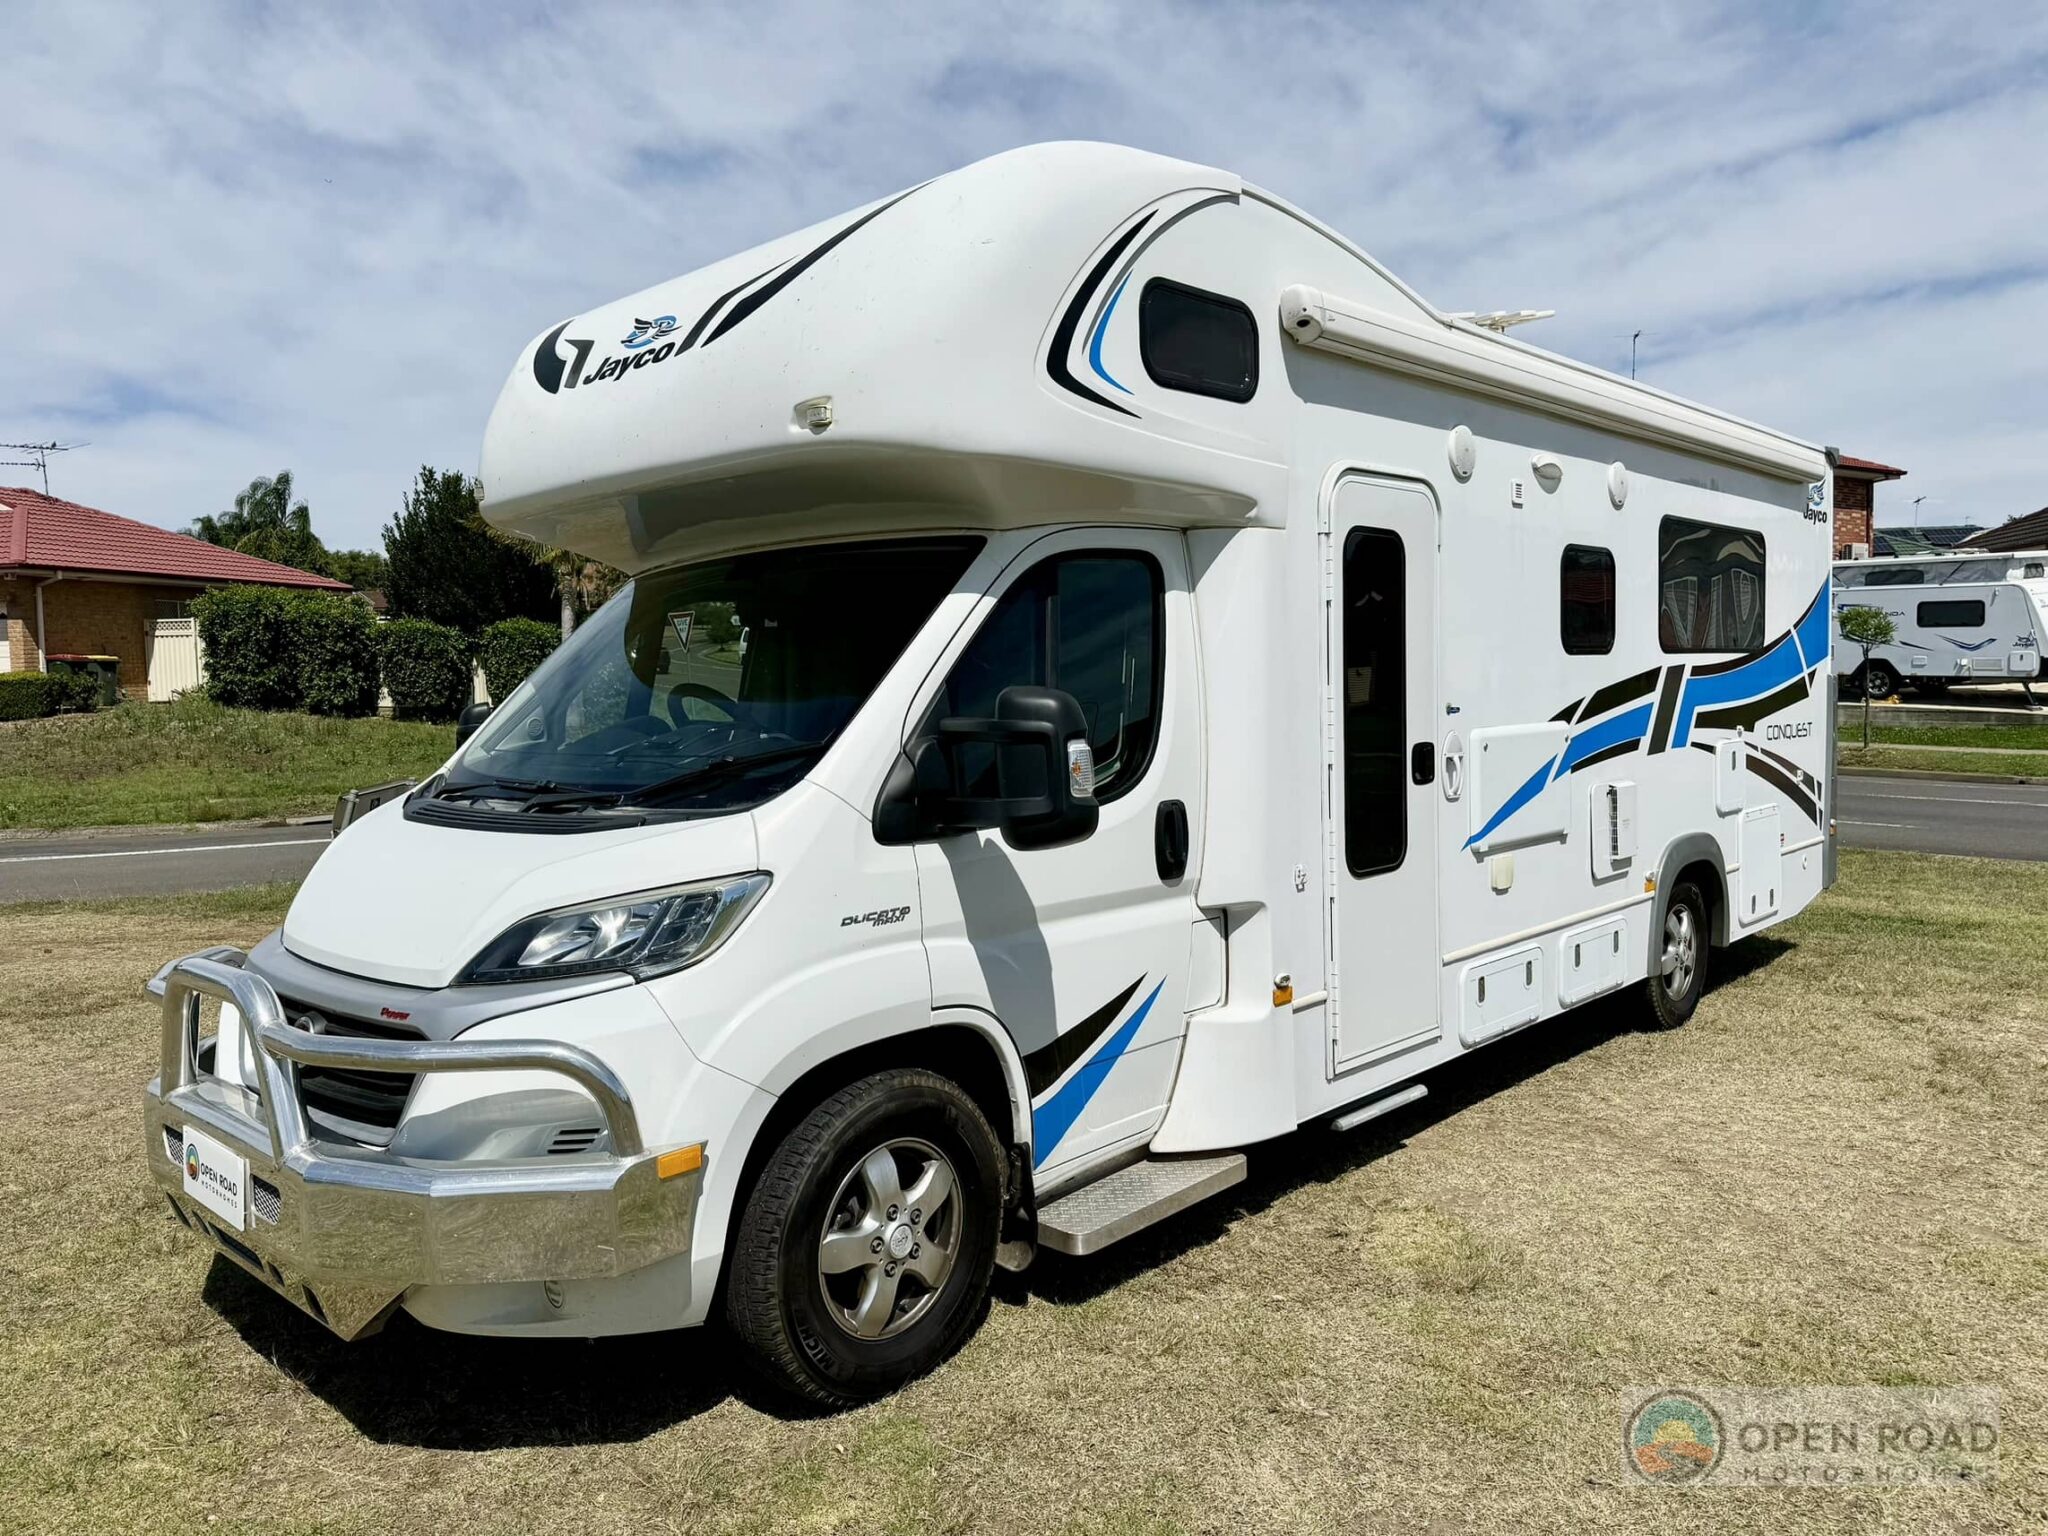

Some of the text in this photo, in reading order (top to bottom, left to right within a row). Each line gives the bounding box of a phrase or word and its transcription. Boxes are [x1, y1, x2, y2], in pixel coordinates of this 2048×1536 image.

[583, 342, 676, 385] Jayco
[1803, 503, 1827, 525] Jayco
[1767, 722, 1813, 740] CONQUEST
[840, 906, 911, 927] DUCATO
[201, 1163, 237, 1196] OPEN ROAD
[201, 1181, 238, 1208] MOTORHOMES
